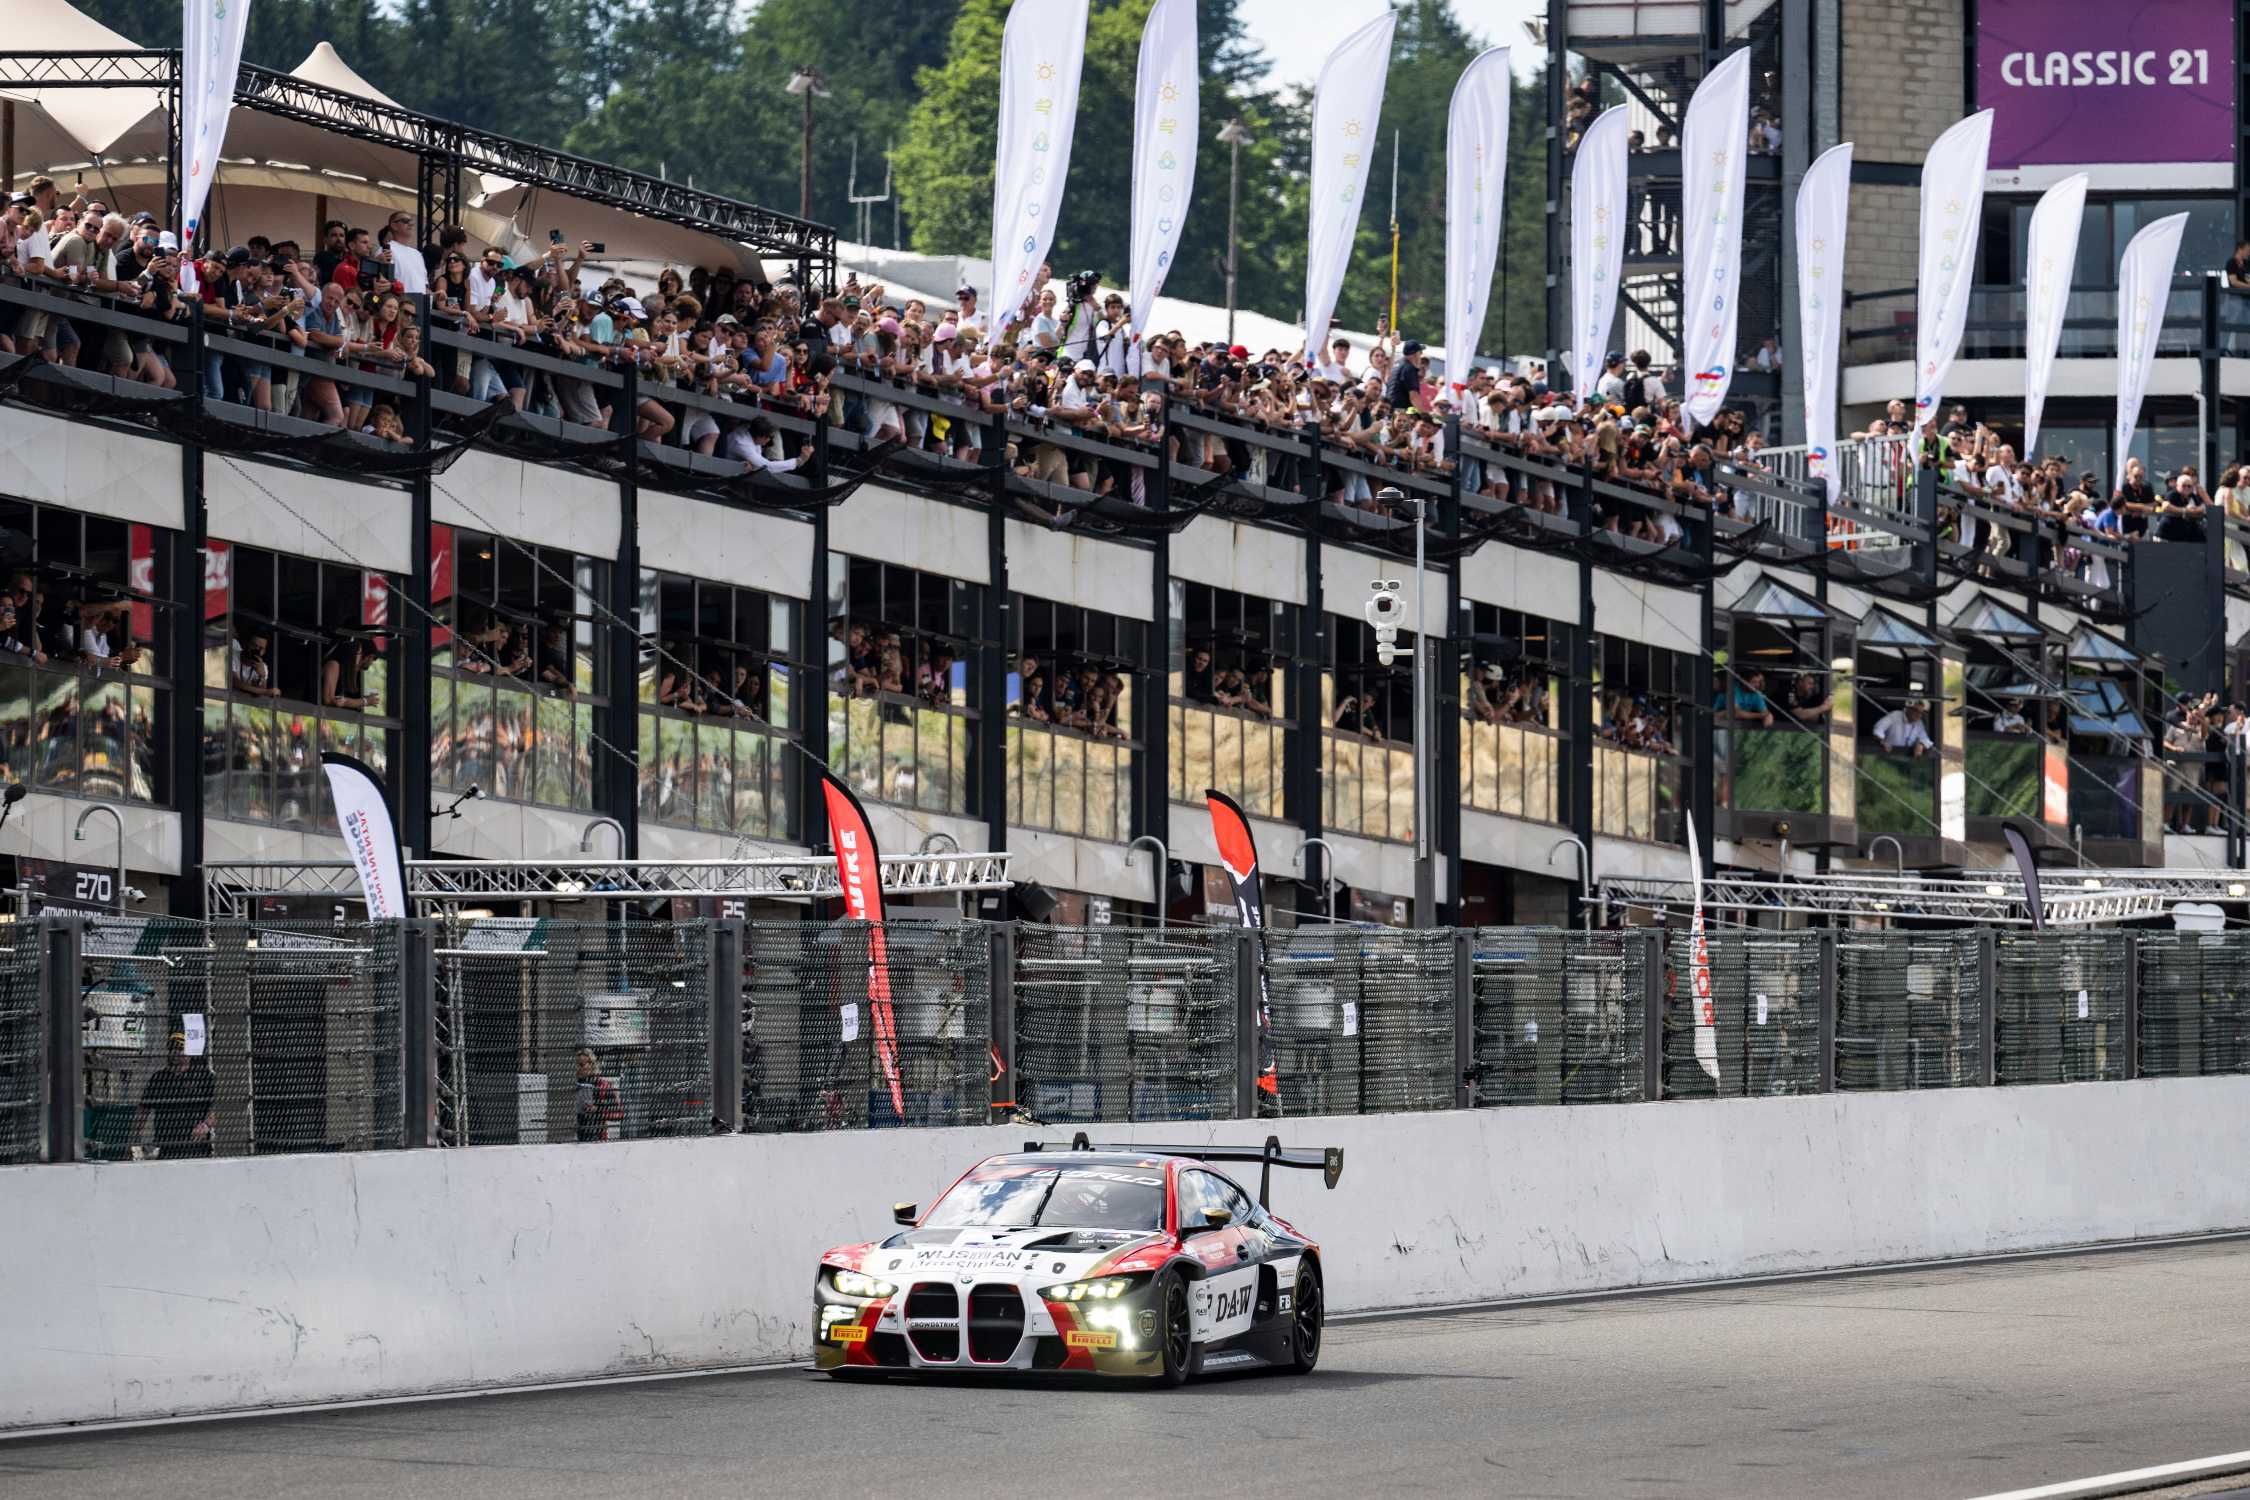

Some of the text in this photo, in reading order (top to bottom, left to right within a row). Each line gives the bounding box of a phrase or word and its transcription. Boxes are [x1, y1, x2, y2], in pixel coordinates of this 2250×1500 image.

[2000, 49, 2209, 87] CLASSIC 21
[75, 872, 111, 902] 270
[916, 1249, 1023, 1261] WIJSMAN
[909, 1321, 960, 1329] CROWDSTRIKE
[833, 1327, 864, 1339] PIRELLI
[1071, 1333, 1113, 1345] PIRELLI
